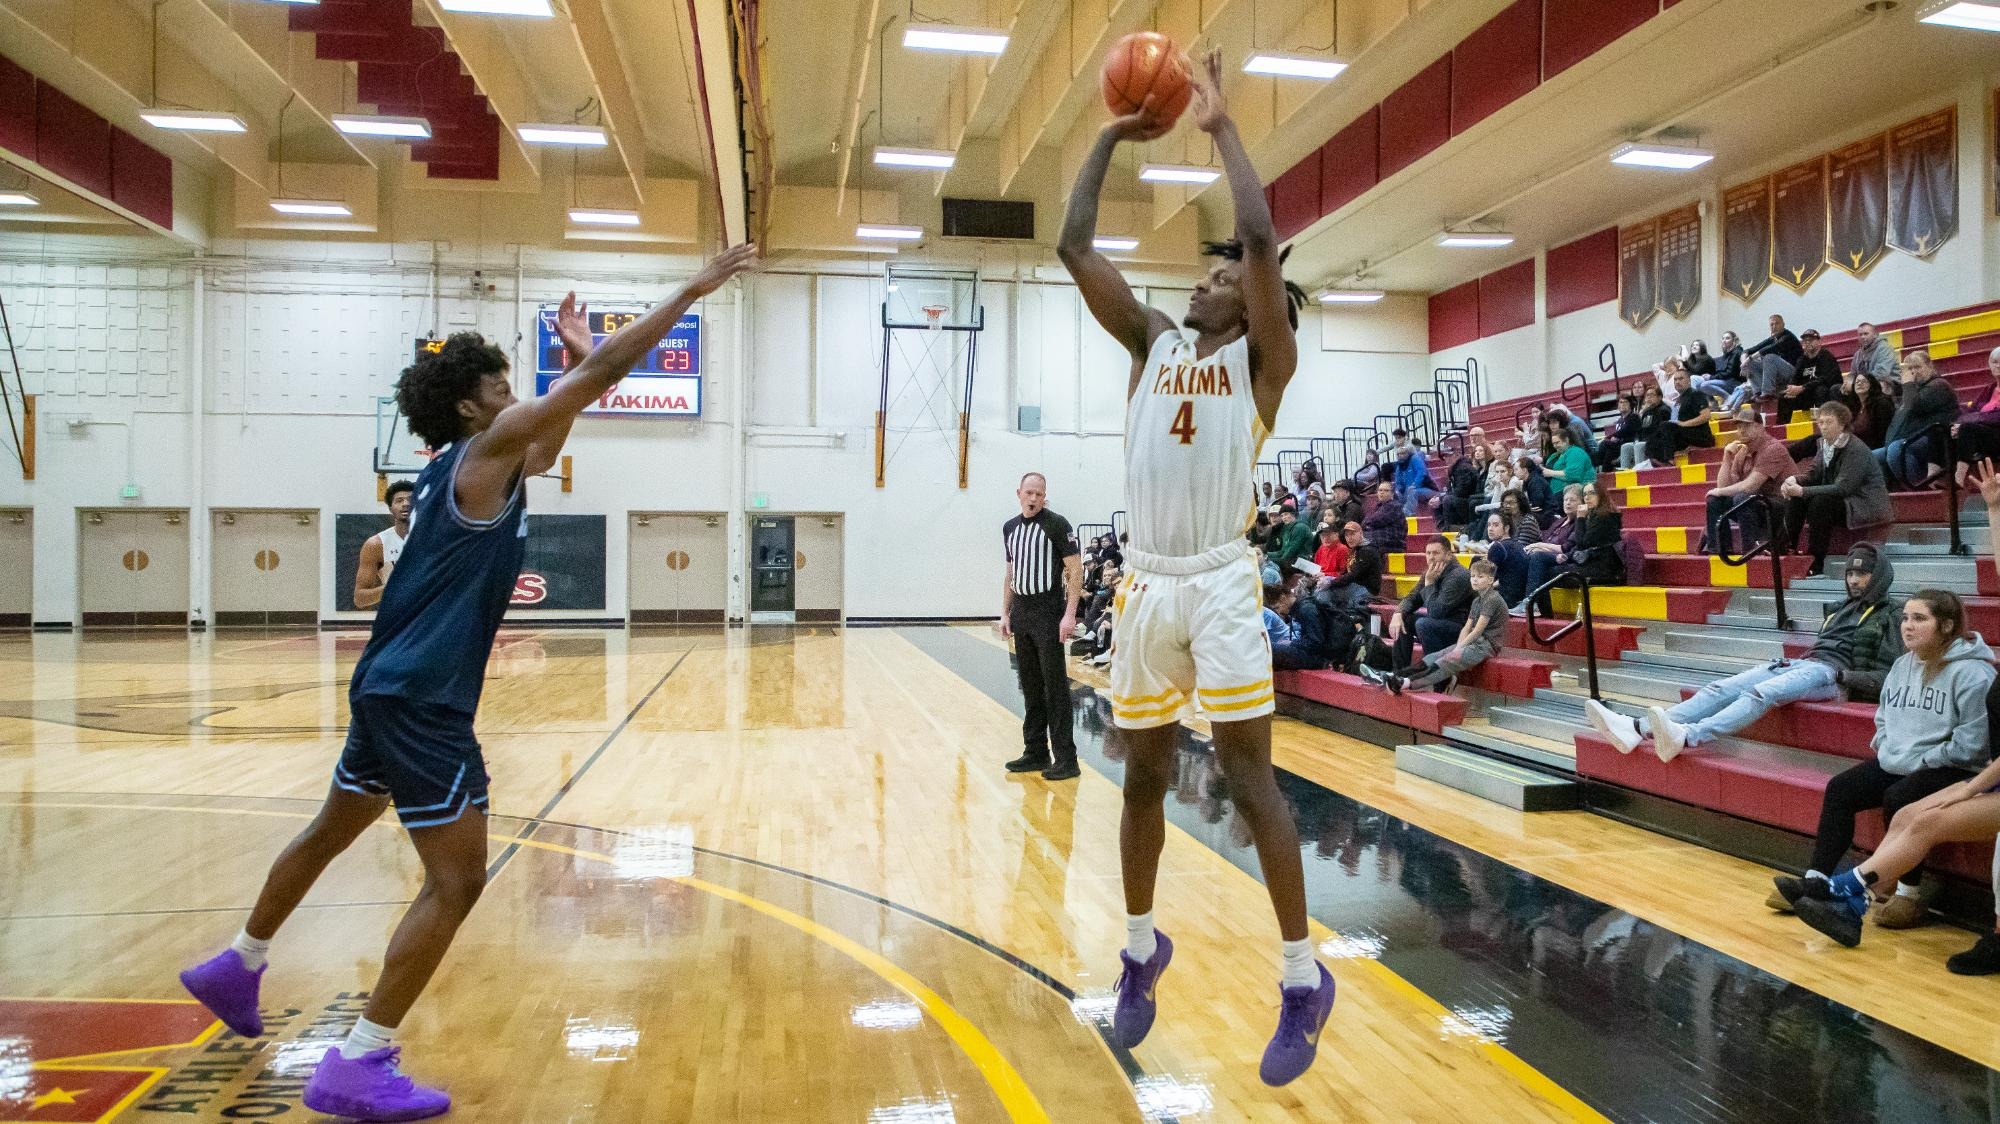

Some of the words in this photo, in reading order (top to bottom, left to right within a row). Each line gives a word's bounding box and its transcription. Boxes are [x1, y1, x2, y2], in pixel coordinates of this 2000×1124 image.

[658, 338, 689, 348] GUEST
[664, 351, 690, 370] 23
[1153, 364, 1232, 396] YAKIMA
[598, 385, 689, 410] YAKIMA
[1169, 400, 1198, 445] 4
